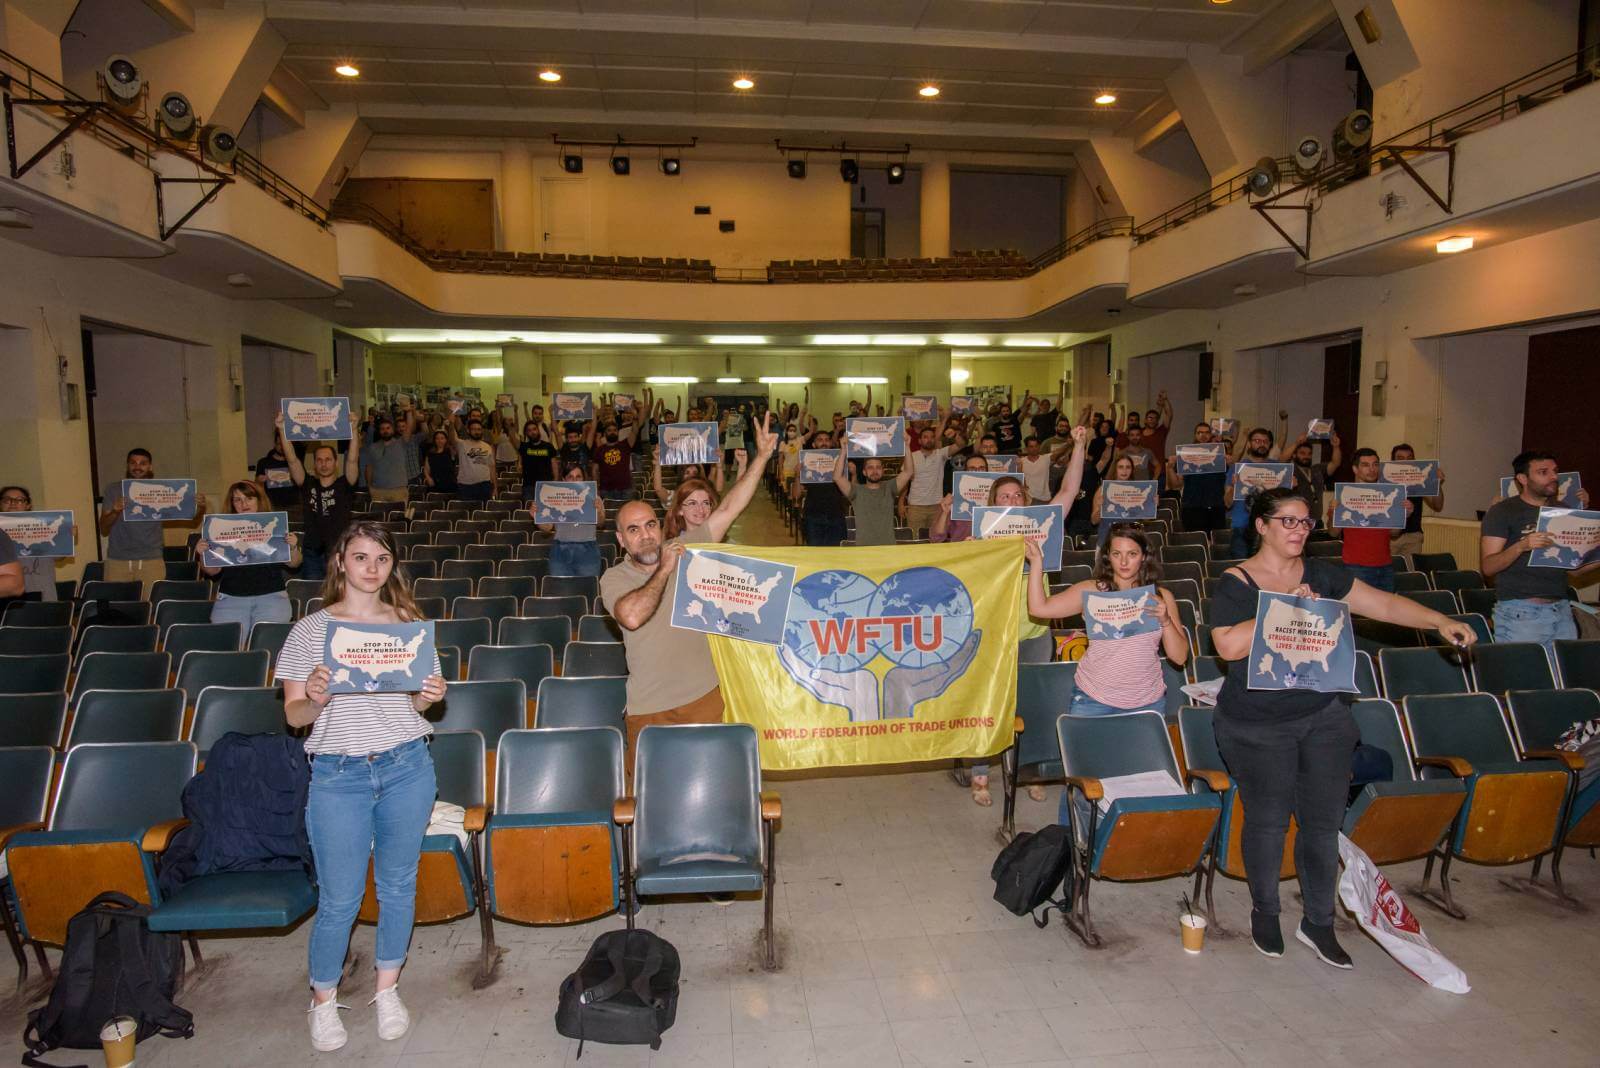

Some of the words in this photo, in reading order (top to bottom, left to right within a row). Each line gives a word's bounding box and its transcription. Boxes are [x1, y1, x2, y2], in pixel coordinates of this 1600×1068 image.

[694, 583, 728, 593] STRUGGLE
[735, 591, 767, 601] WORKERS
[702, 578, 726, 586] RACIST
[727, 582, 760, 593] MURDERS.
[704, 591, 724, 599] LIVES
[728, 596, 754, 605] RIGHTS!
[808, 615, 943, 656] WFTU
[1275, 626, 1296, 634] RACIST
[1268, 634, 1297, 642] STRUGGLE
[1302, 637, 1336, 646] WORKERS
[1295, 644, 1322, 652] RIGHTS!
[763, 728, 808, 740] WORLD
[812, 723, 887, 738] FEDERATION
[890, 722, 906, 733] OF
[909, 720, 945, 732] TRADE
[948, 717, 994, 729] UNIONS
